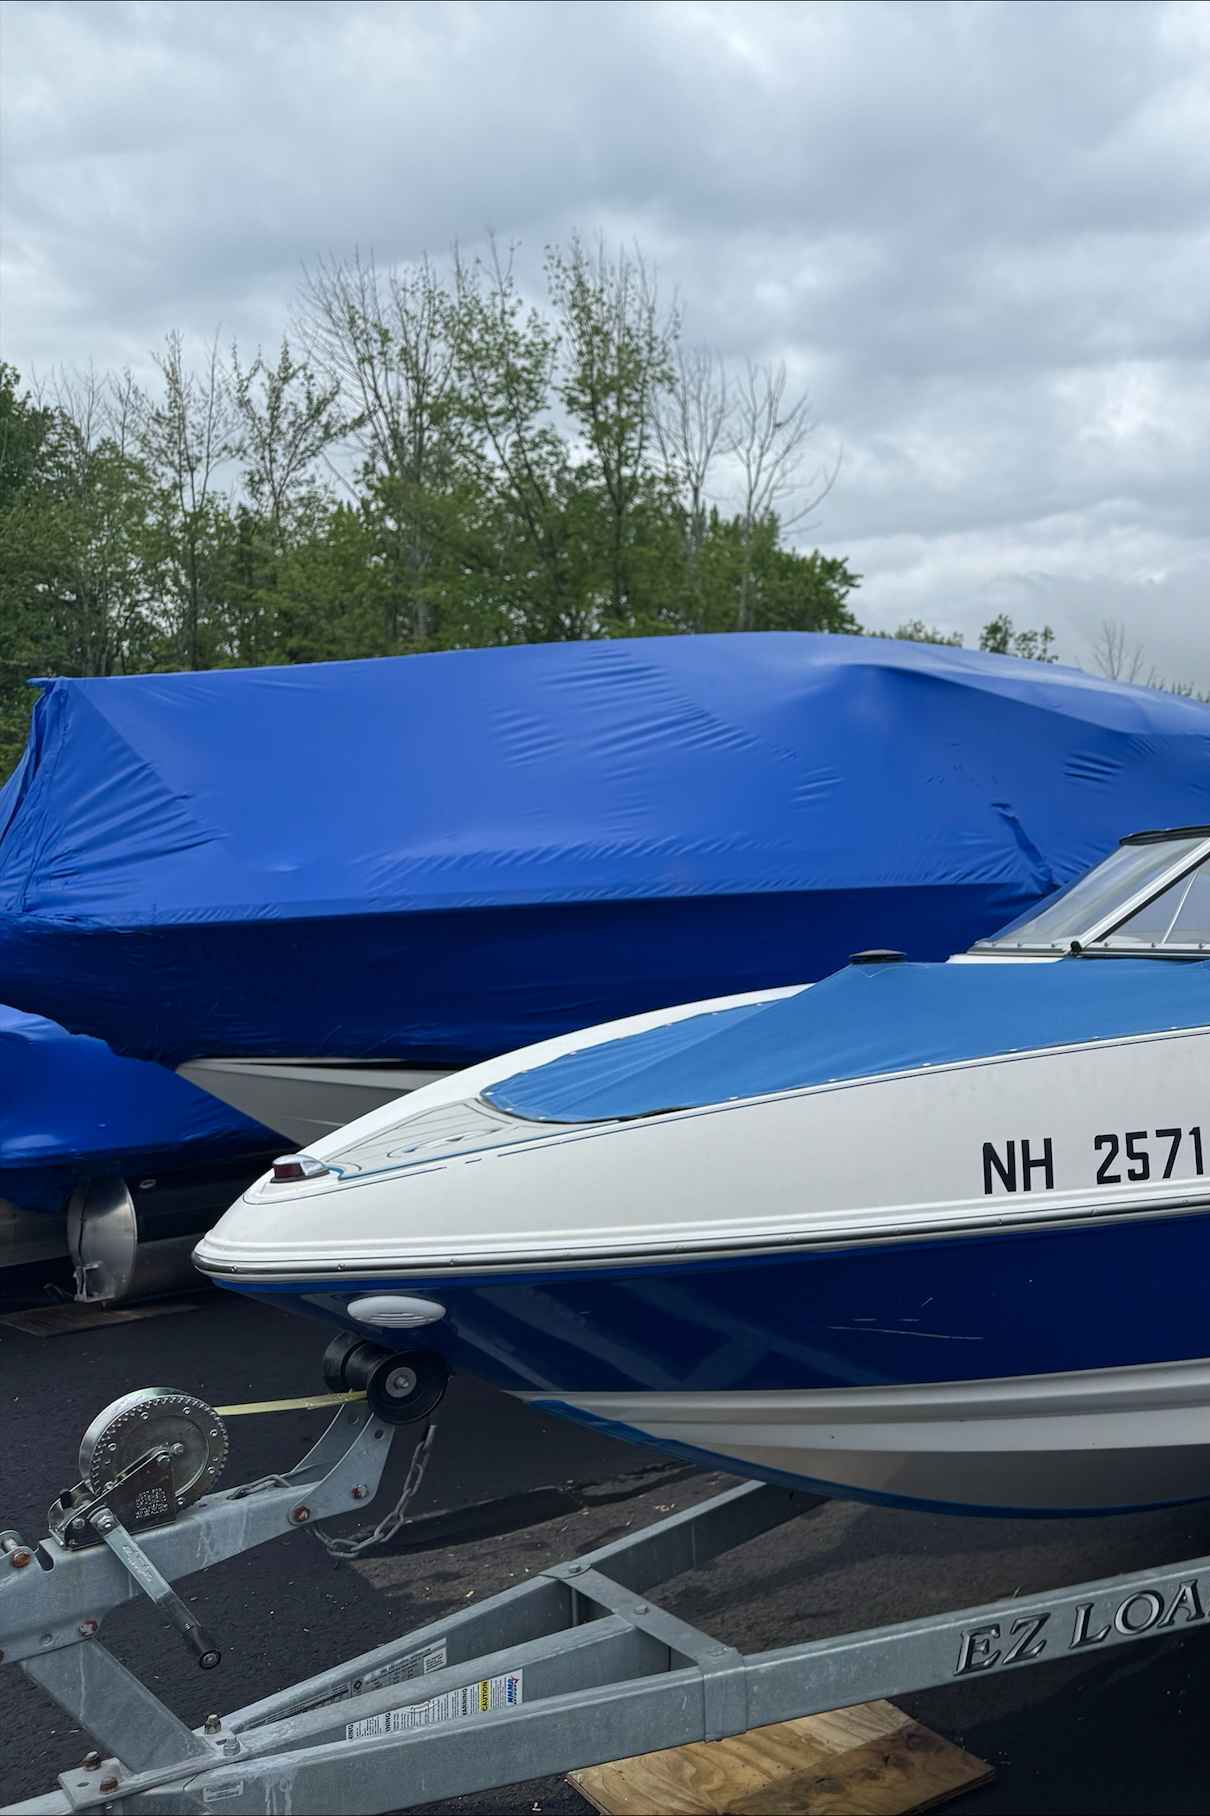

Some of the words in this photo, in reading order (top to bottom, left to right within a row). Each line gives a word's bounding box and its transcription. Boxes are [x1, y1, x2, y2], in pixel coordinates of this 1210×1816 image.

[982, 1138, 1054, 1195] NH
[1094, 1127, 1204, 1185] 2571
[953, 1612, 1051, 1677] EZ
